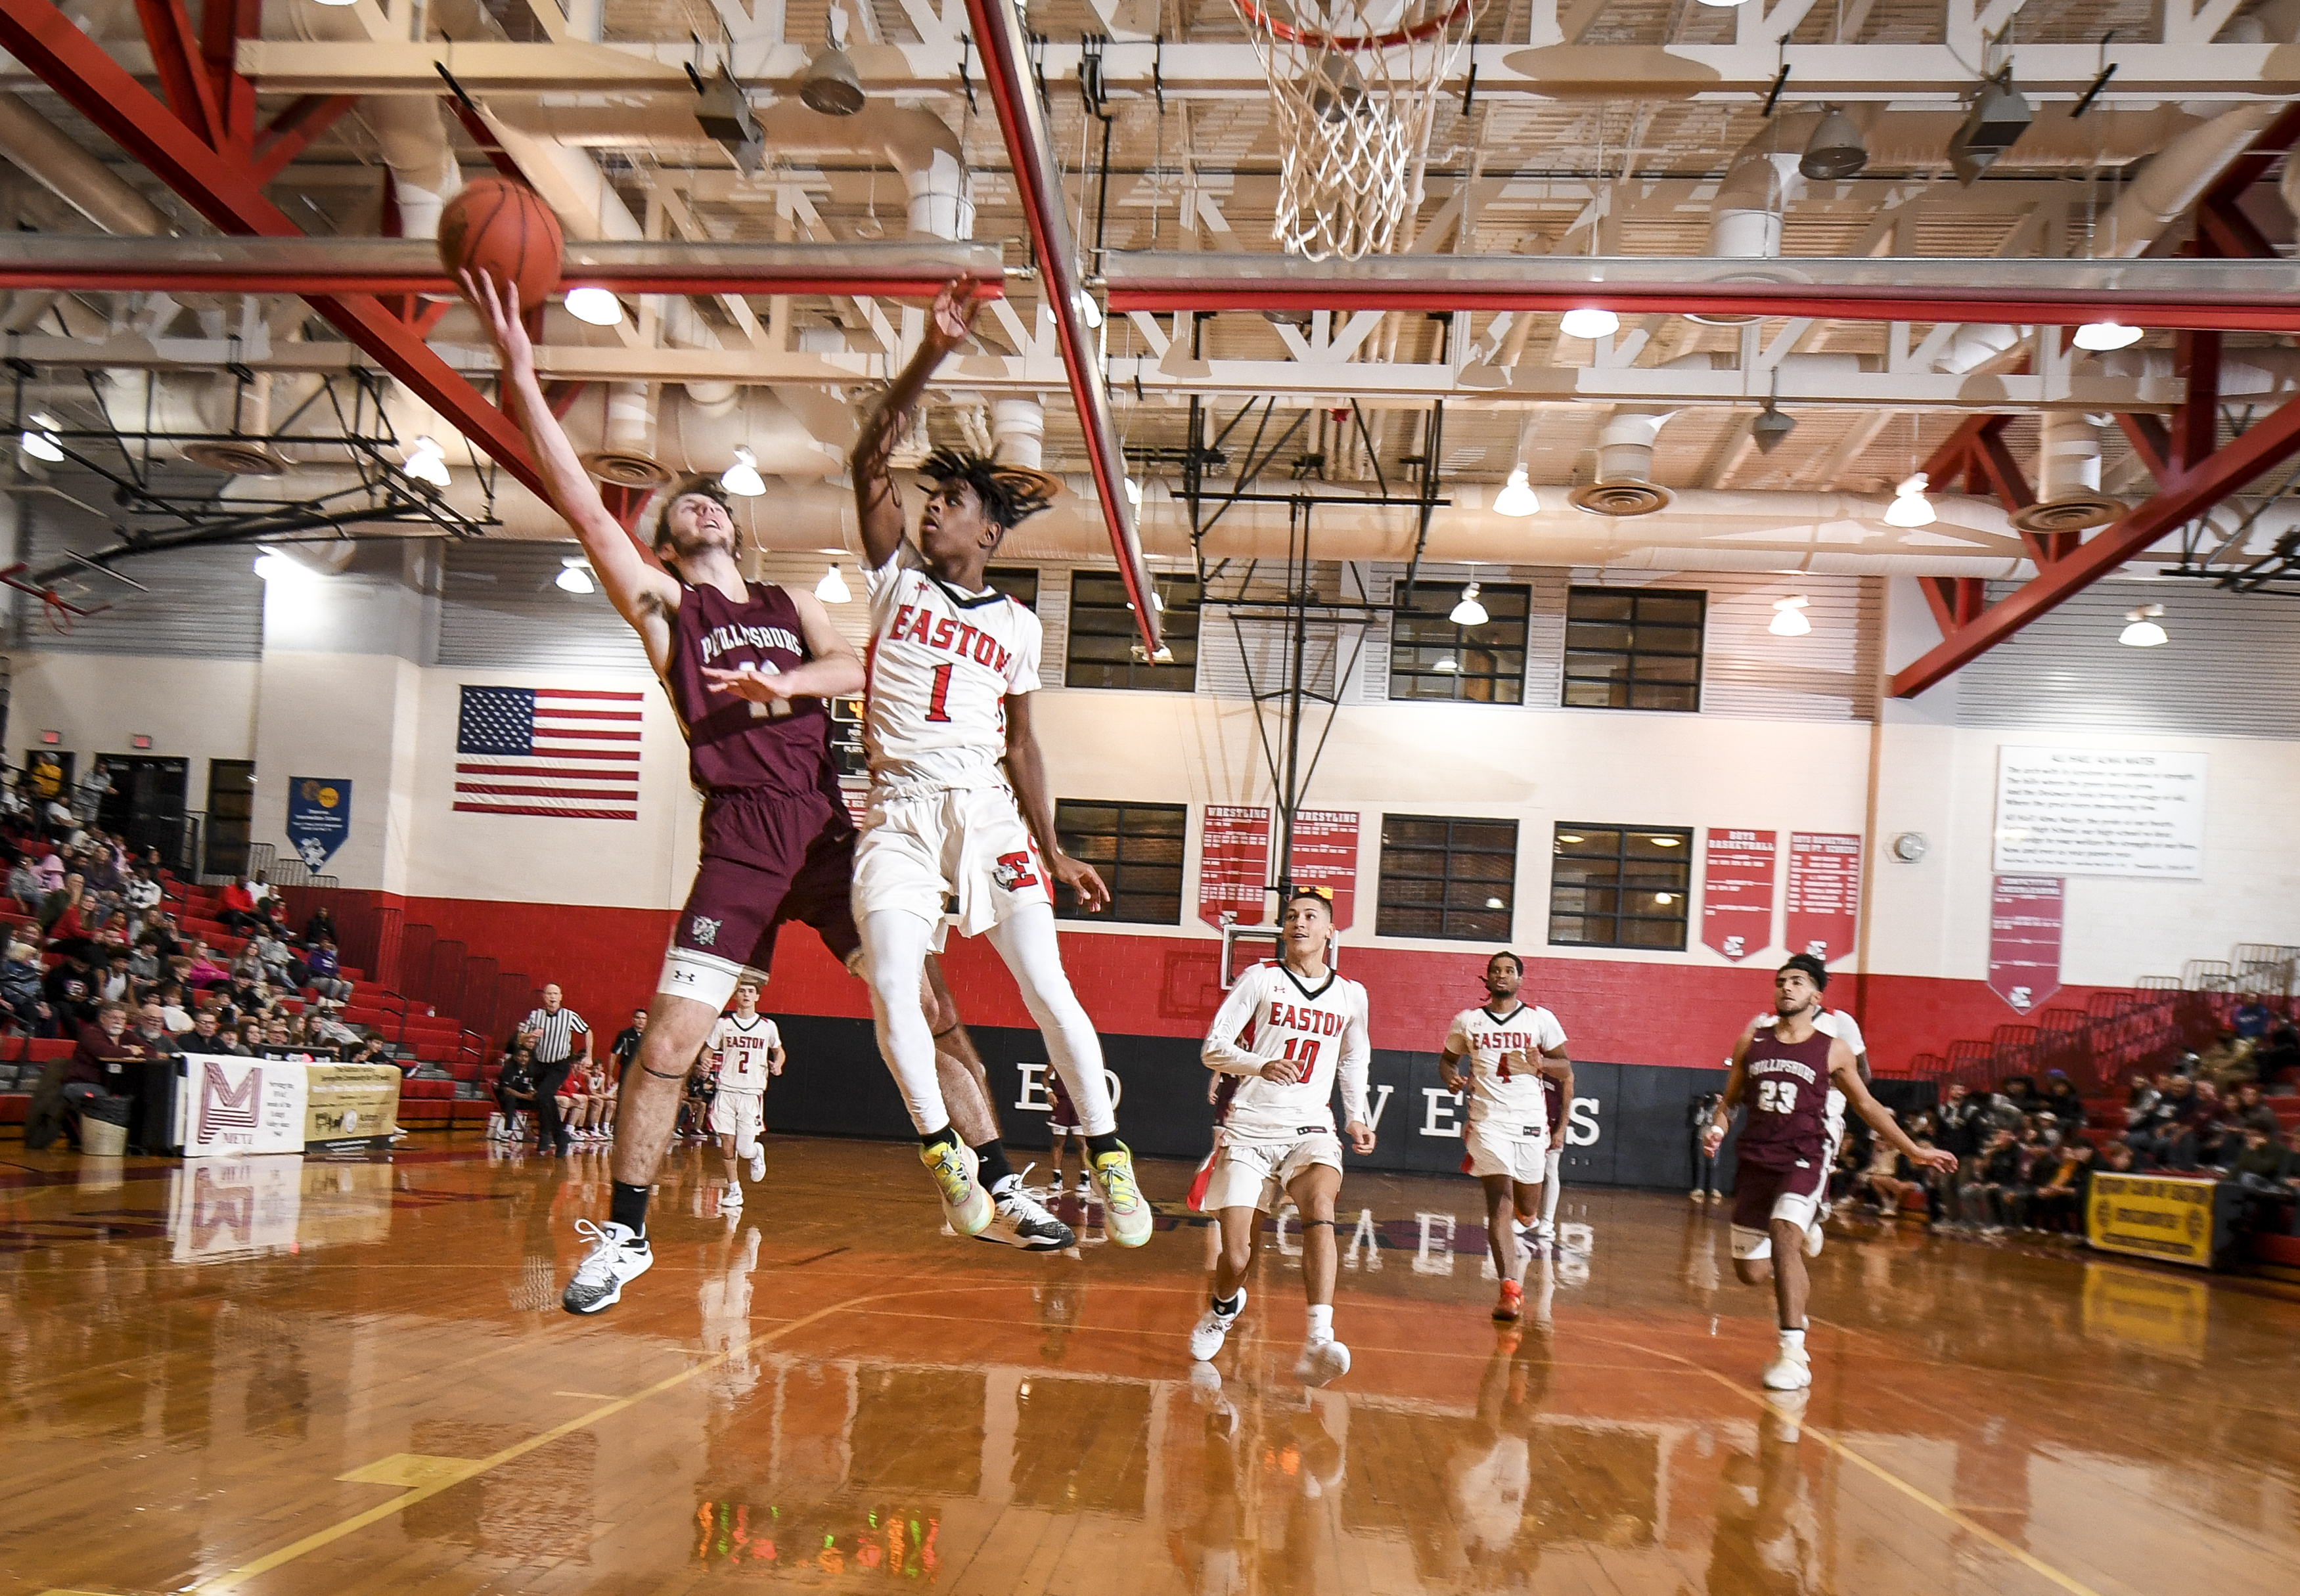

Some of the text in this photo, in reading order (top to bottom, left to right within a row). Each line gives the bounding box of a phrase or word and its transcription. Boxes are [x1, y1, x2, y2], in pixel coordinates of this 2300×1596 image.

[925, 663, 953, 723] 1
[1207, 807, 1267, 819] WRESTLING
[1296, 811, 1357, 824] WRESTLING
[1708, 839, 1775, 852] BASKETBALL
[1728, 831, 1755, 841] BOYS
[1268, 1002, 1344, 1038] EASTON
[726, 1036, 765, 1050] EASTON
[1472, 1032, 1531, 1049] EASTON
[738, 1052, 750, 1074] 2
[1283, 1038, 1320, 1084] 10
[1497, 1053, 1512, 1084] 4
[1757, 1080, 1799, 1114] 23
